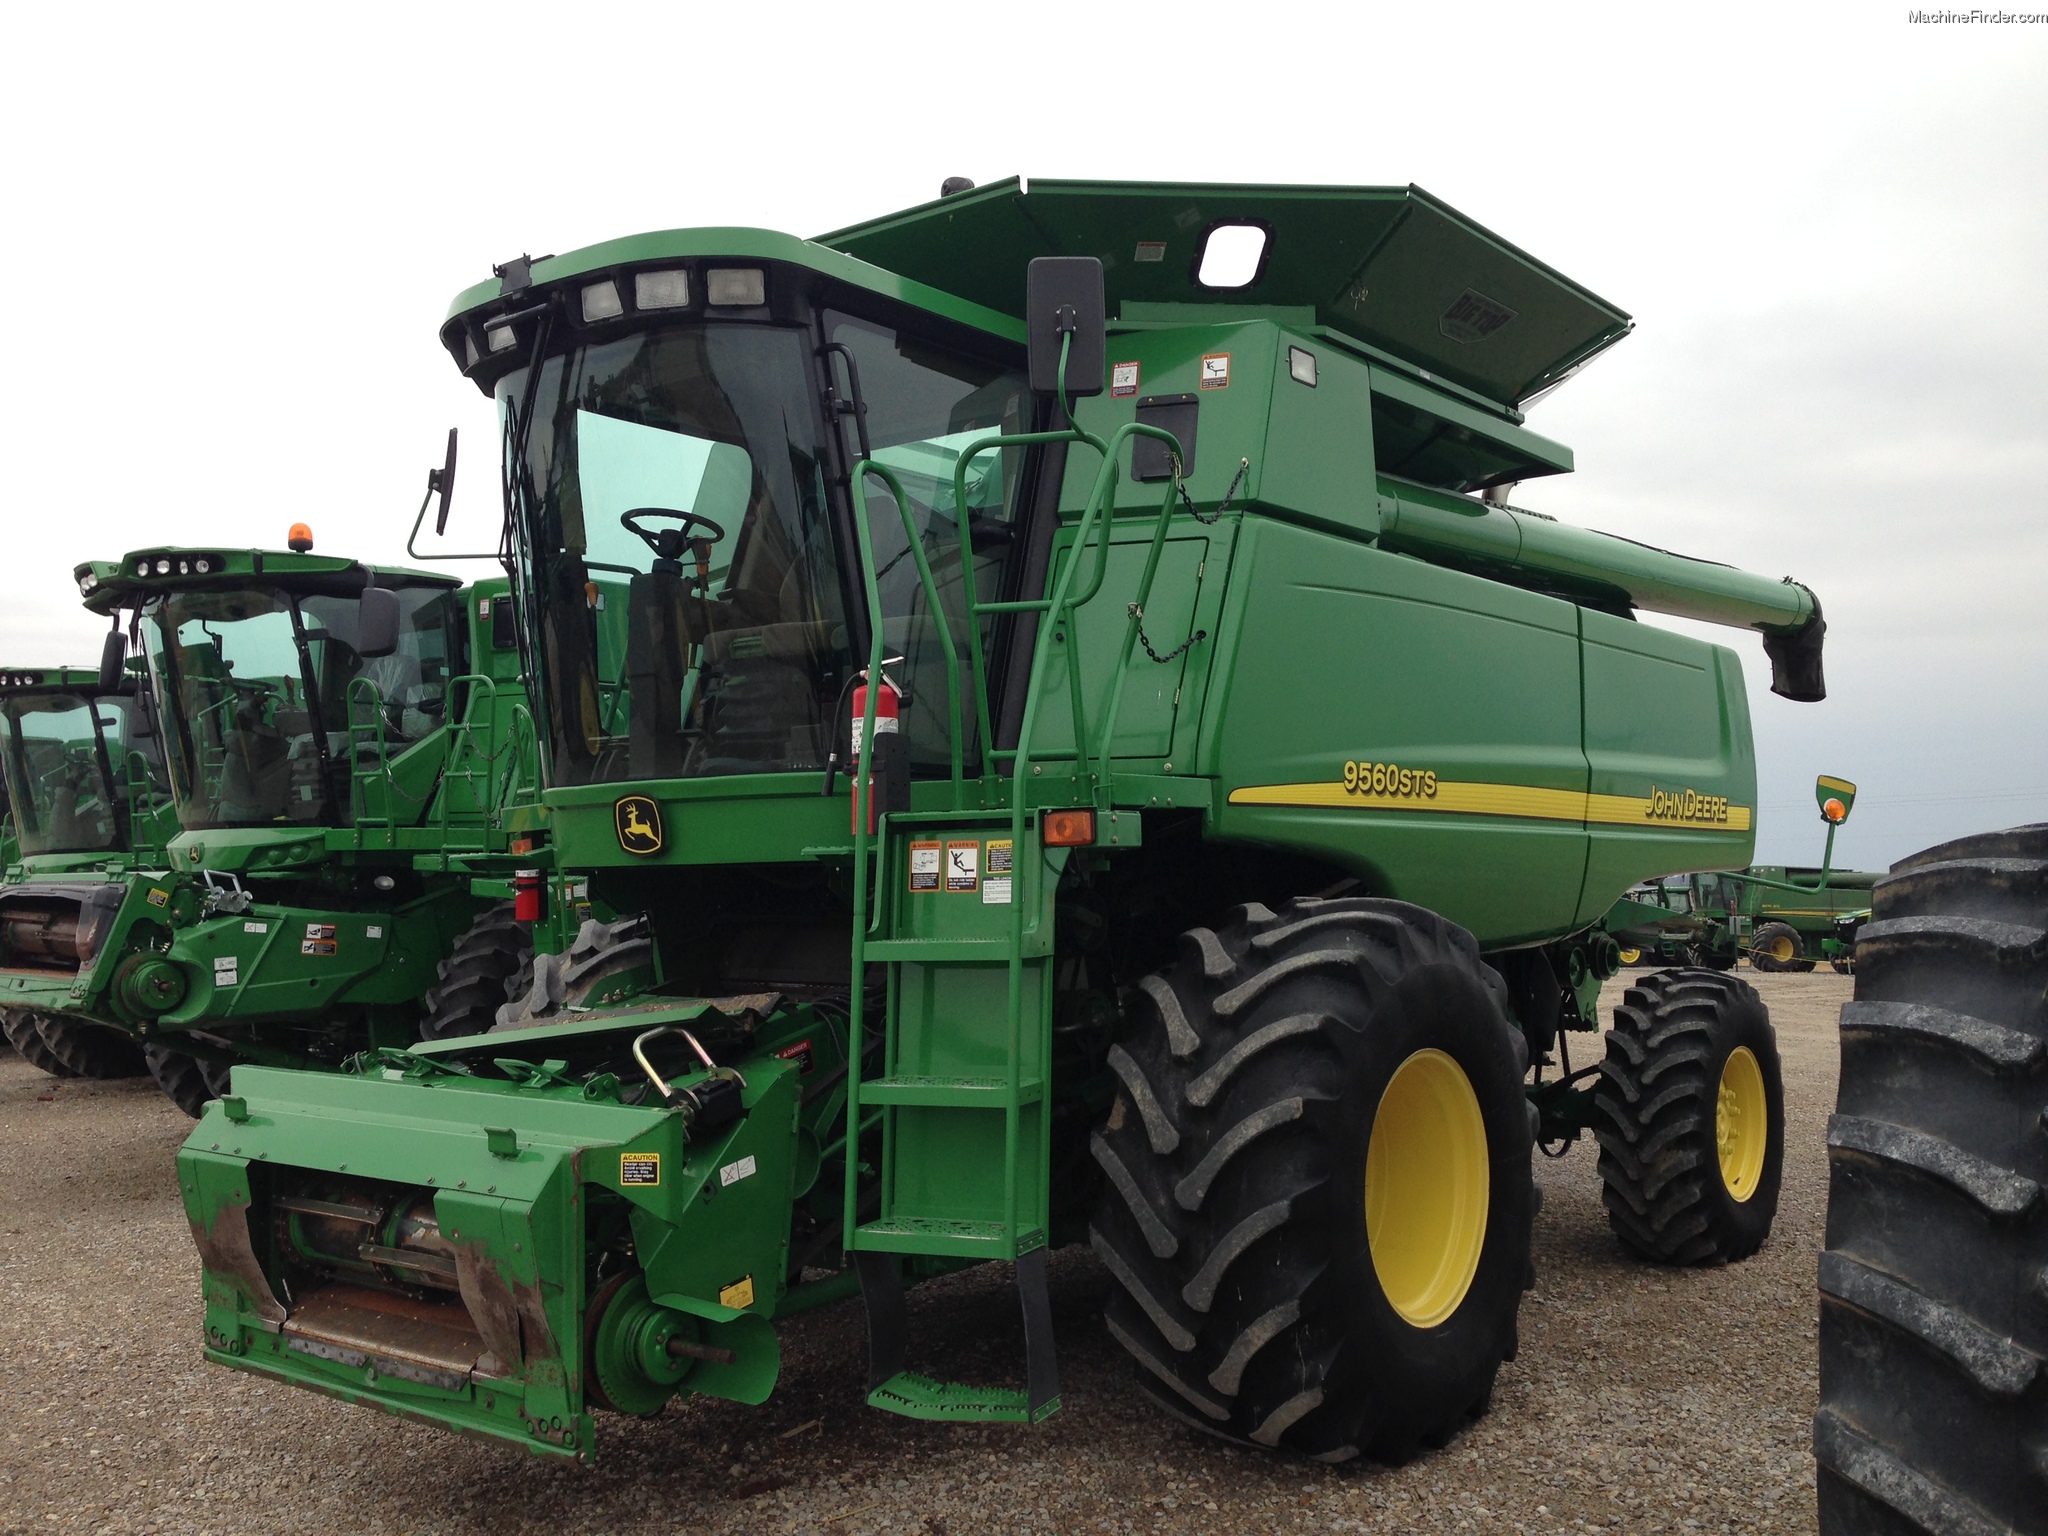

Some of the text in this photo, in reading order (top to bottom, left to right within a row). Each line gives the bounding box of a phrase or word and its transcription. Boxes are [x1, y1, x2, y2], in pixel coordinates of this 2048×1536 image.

[1343, 759, 1438, 797] 9560STS
[1645, 784, 1728, 822] JOHN DEERE
